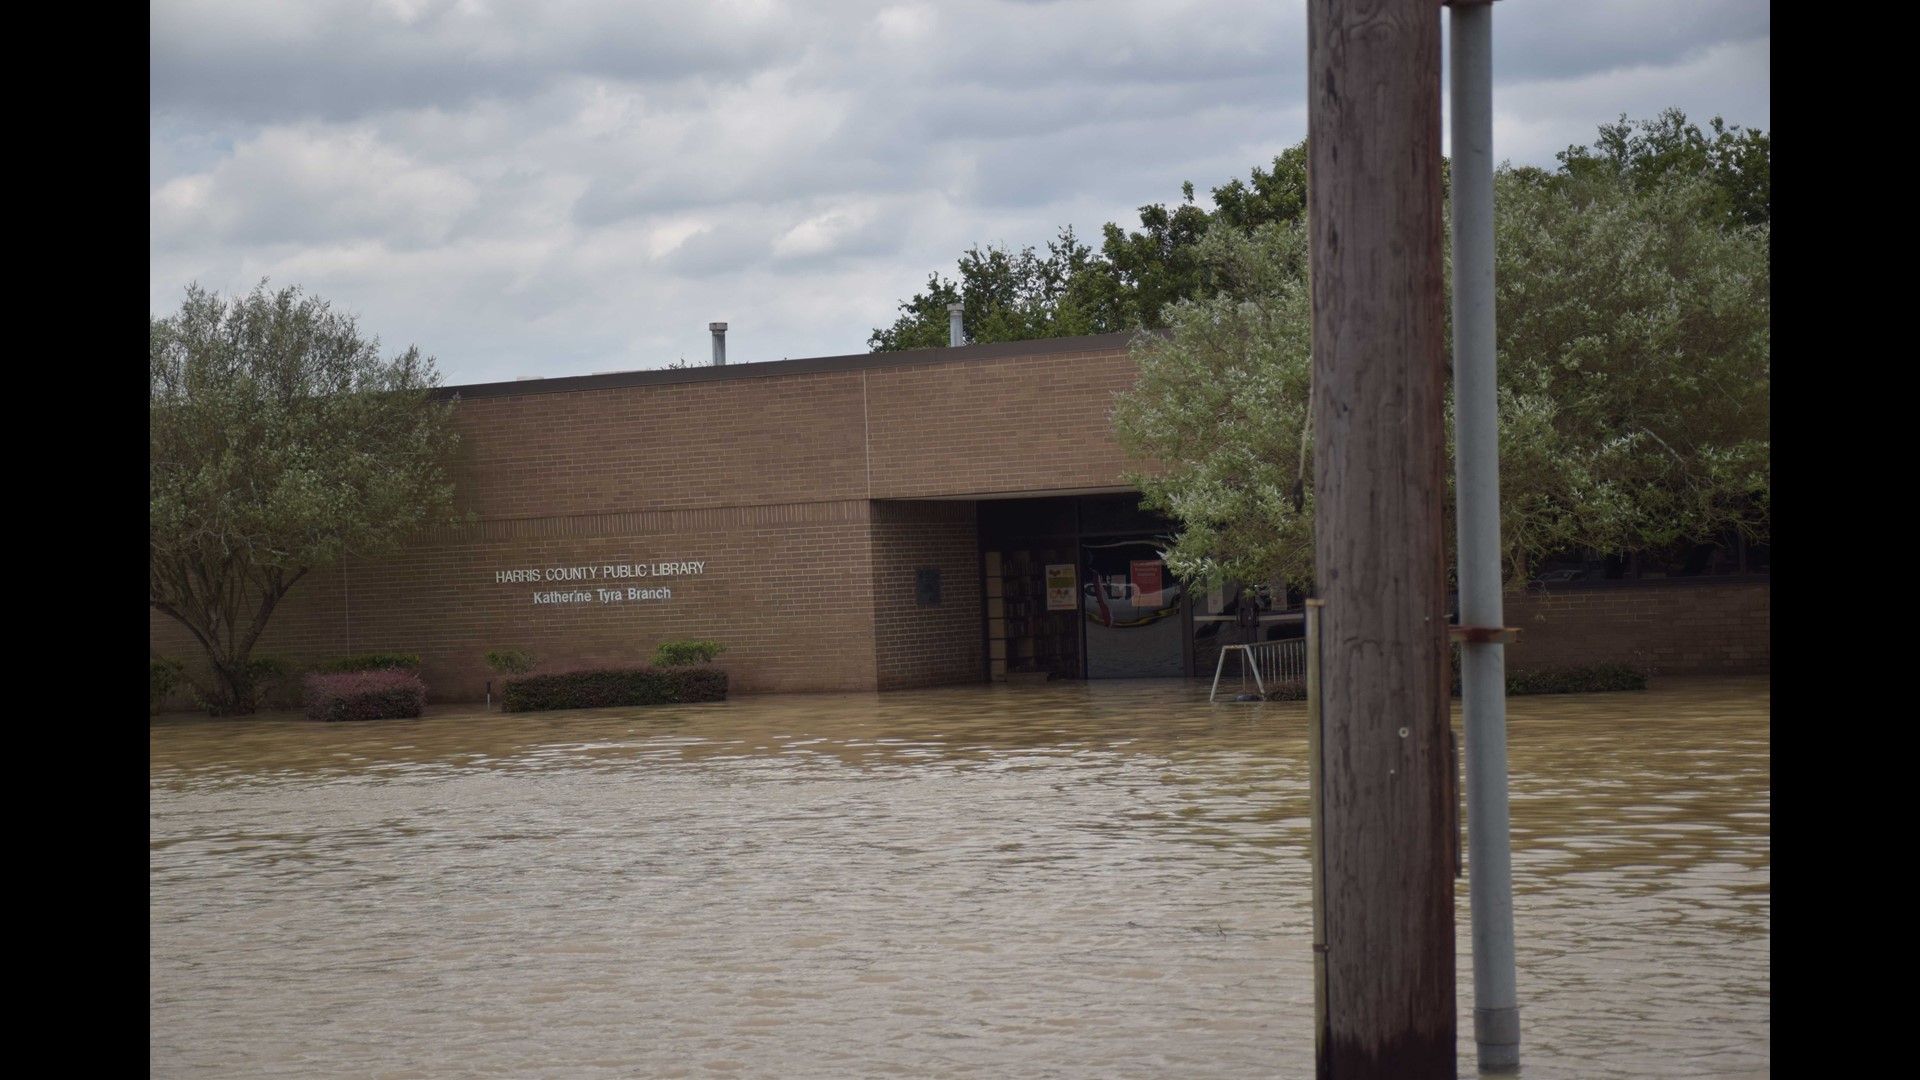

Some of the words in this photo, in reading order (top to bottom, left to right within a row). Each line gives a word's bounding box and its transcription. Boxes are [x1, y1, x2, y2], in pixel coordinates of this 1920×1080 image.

[495, 569, 541, 583] HARRIS
[545, 566, 598, 581] COUNTY
[603, 564, 647, 578] PUBLIC
[652, 561, 705, 576] LIBRARY
[533, 590, 592, 604] Katherine
[597, 588, 623, 604] Tyra
[628, 586, 671, 600] Branch
